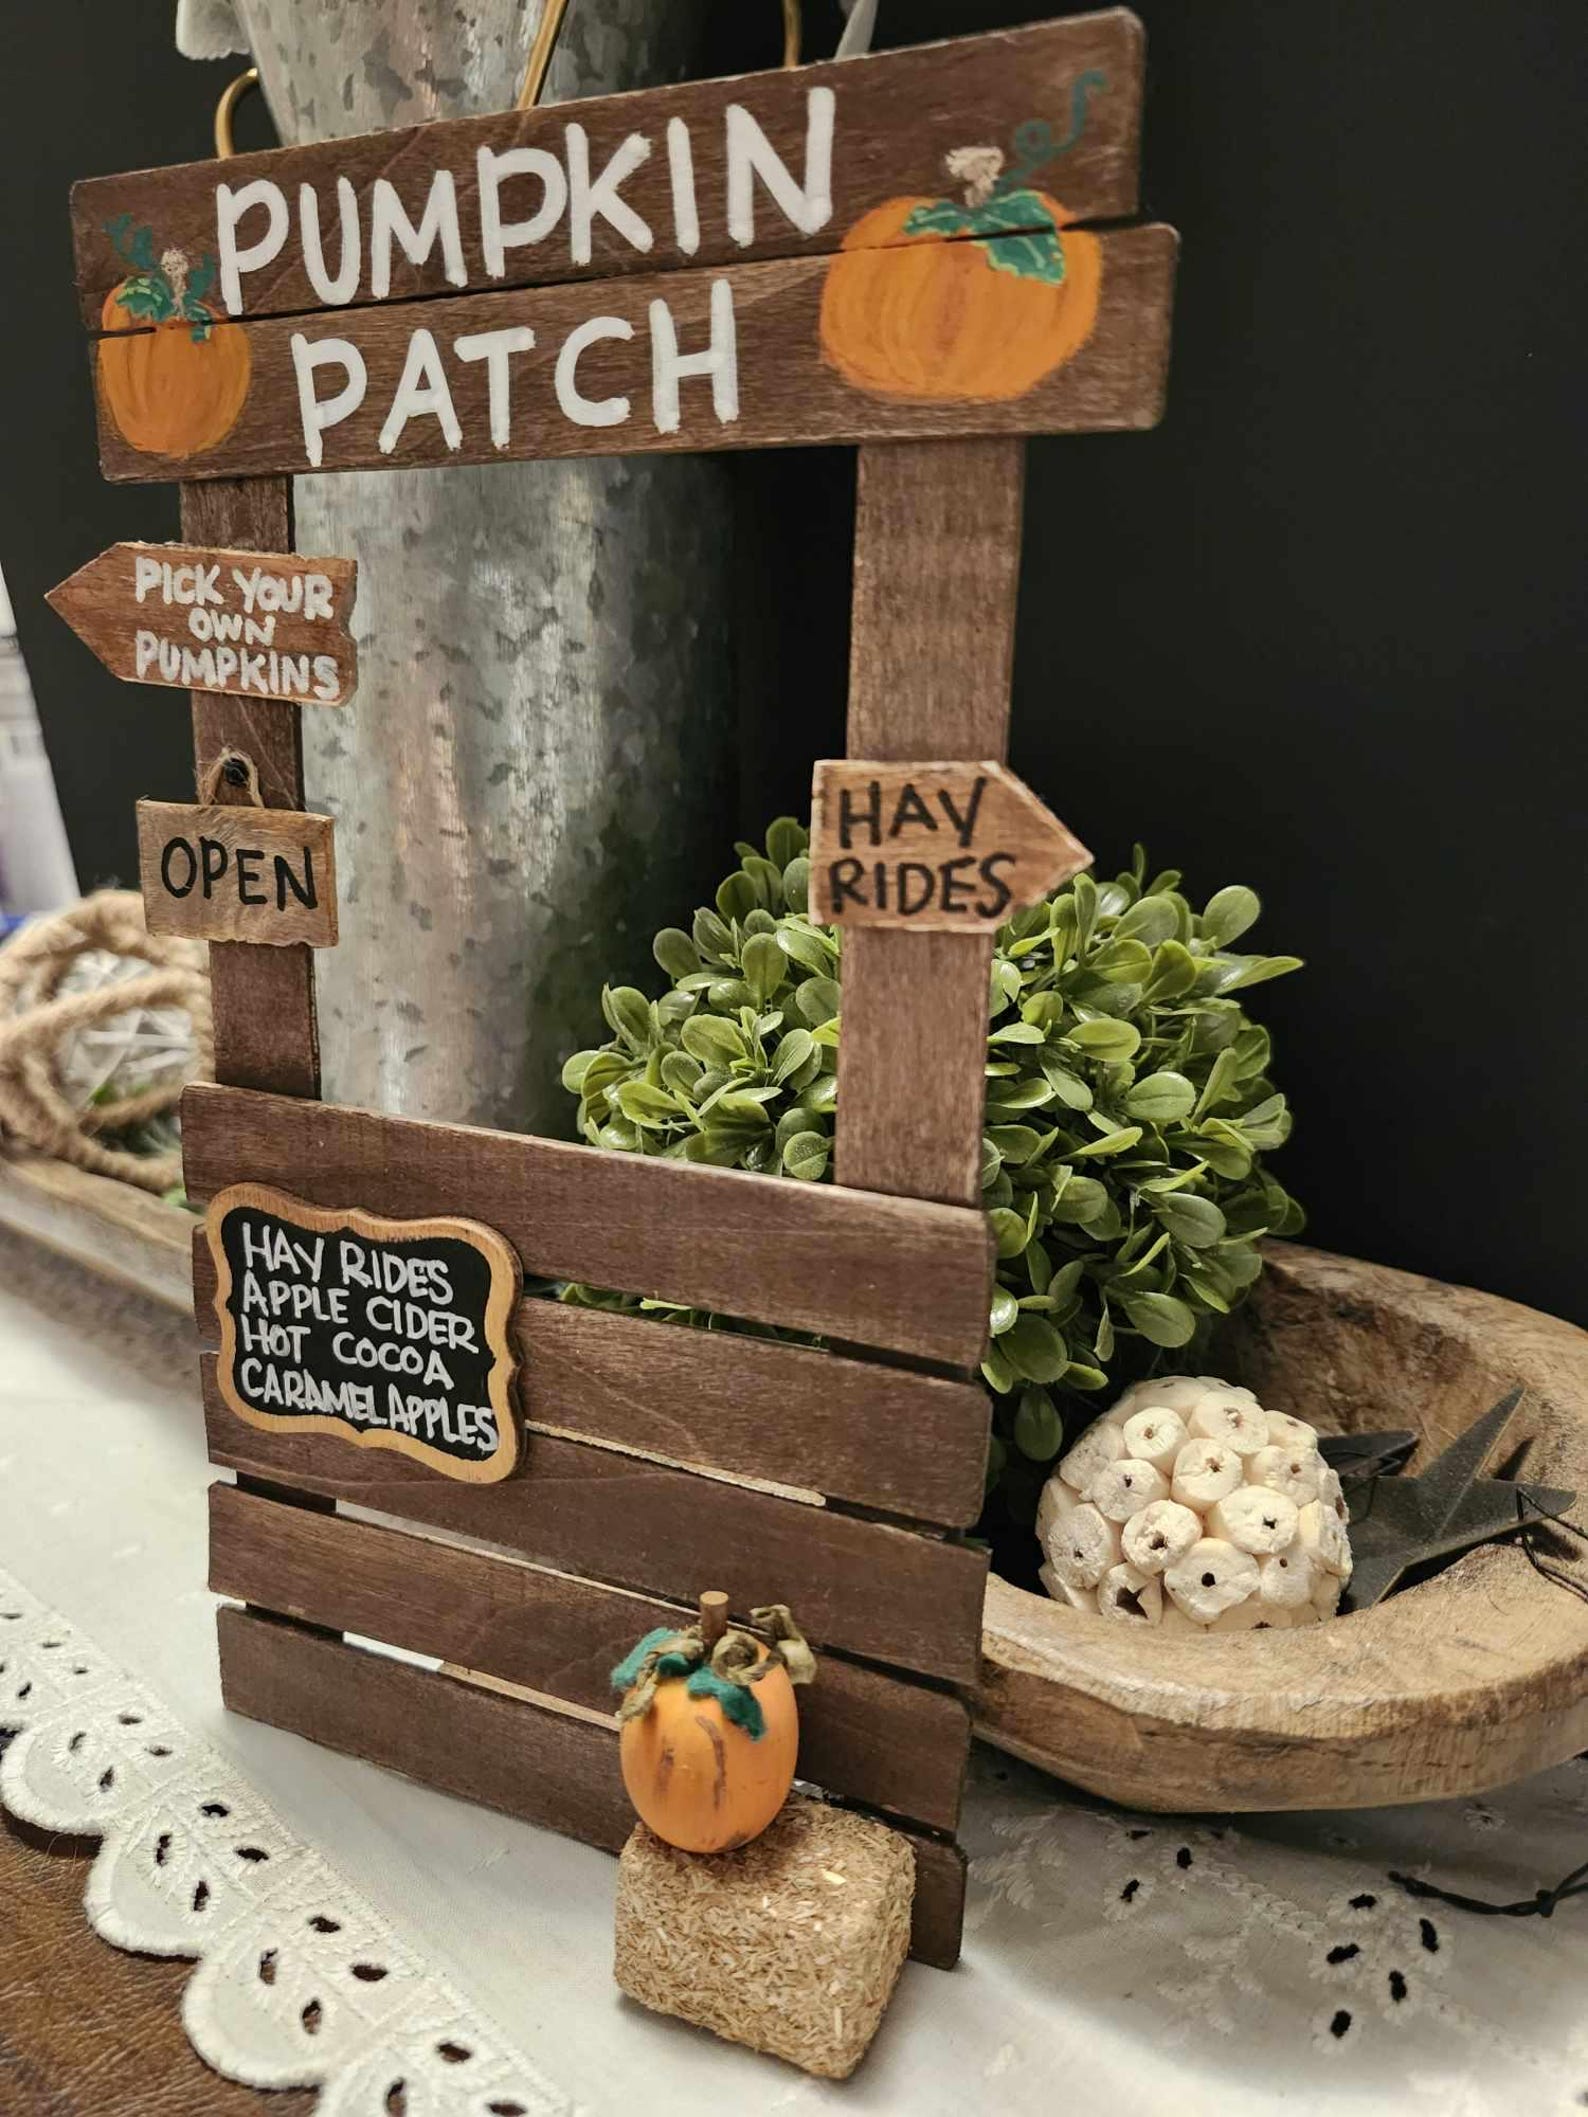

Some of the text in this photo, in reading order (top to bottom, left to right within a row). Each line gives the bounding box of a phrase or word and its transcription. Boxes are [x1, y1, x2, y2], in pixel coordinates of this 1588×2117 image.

[216, 86, 836, 315] PUMPKIN
[291, 279, 740, 466] PATCH
[135, 556, 334, 620] PICK YOUR
[188, 607, 276, 646] OWN
[135, 630, 340, 700] PUMPKINS
[839, 776, 987, 849] HAY
[161, 836, 318, 911] OPEN
[828, 852, 1017, 918] RIDES
[242, 1222, 453, 1305] HAY RIDES
[243, 1269, 479, 1353] APPLE CIDER
[241, 1314, 454, 1390] HOT COCOA
[241, 1358, 498, 1451] CARAMEL APPLES
